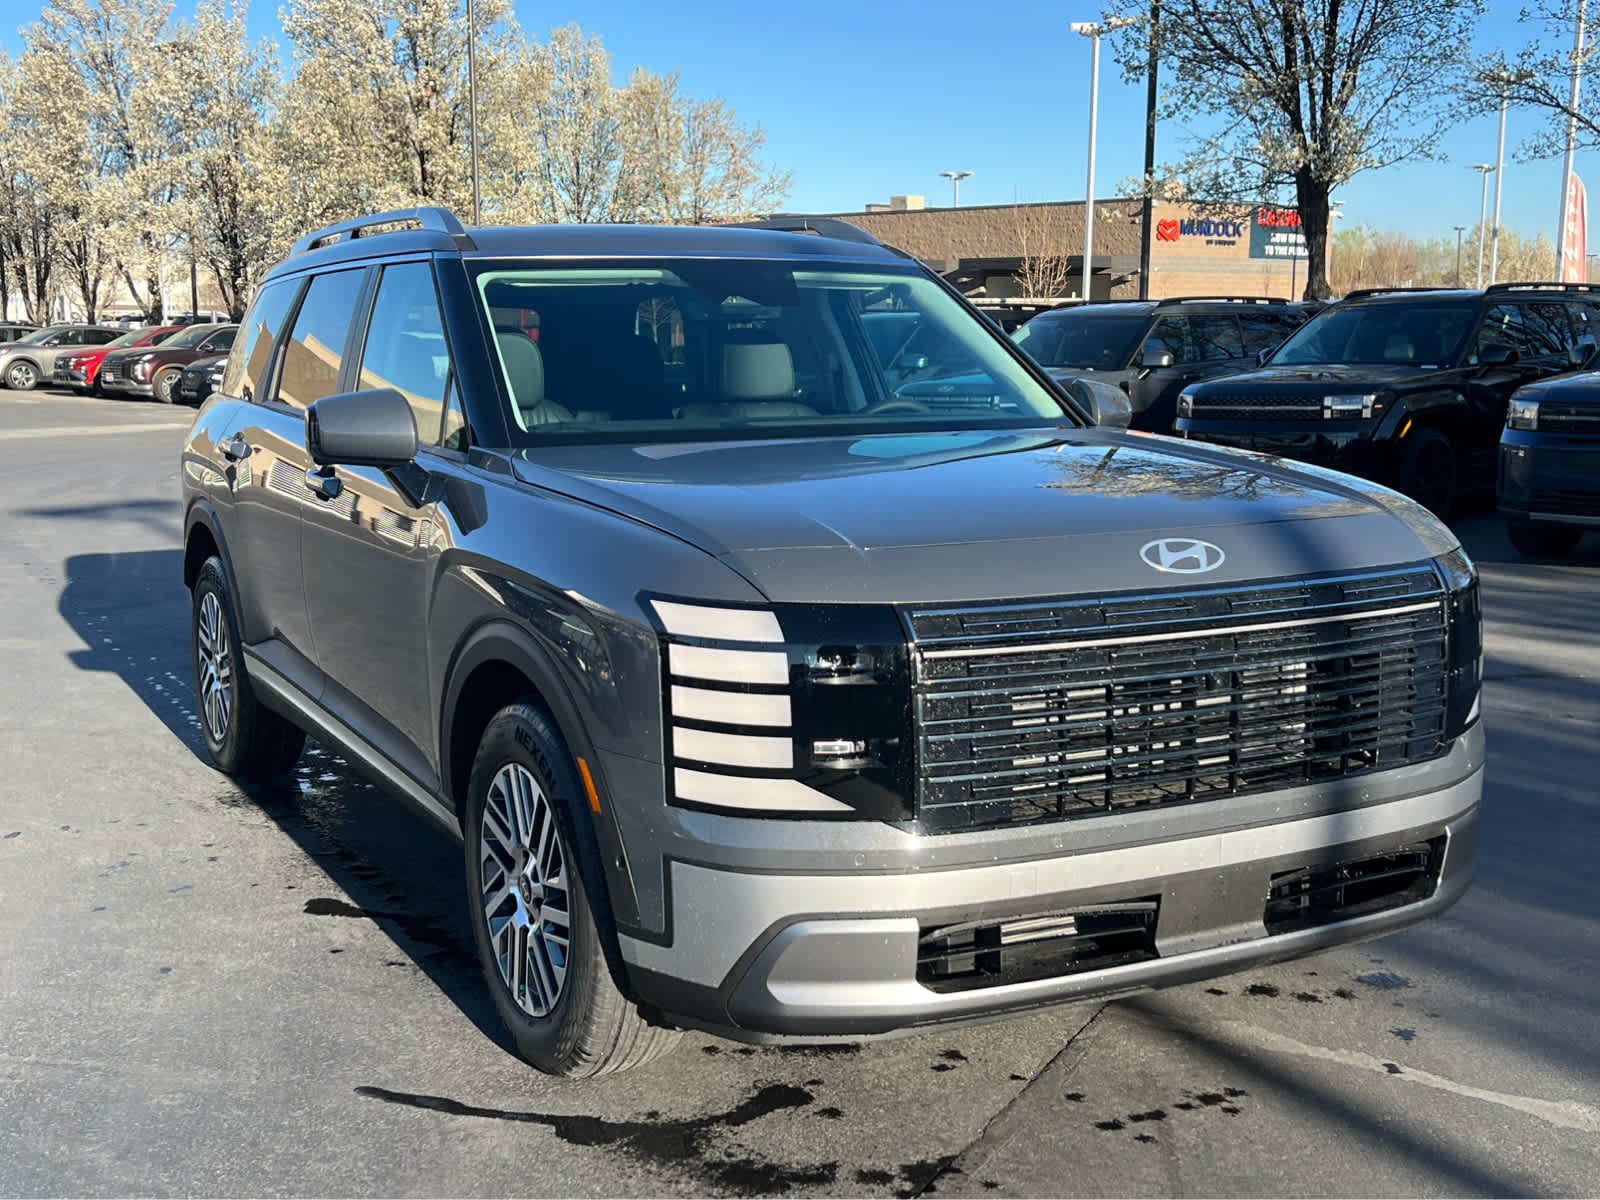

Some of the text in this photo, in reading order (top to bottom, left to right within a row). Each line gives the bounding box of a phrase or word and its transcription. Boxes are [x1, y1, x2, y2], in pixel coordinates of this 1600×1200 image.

[1180, 219, 1242, 237] MURDOCK
[1264, 245, 1274, 256] TO
[1274, 245, 1288, 256] THE
